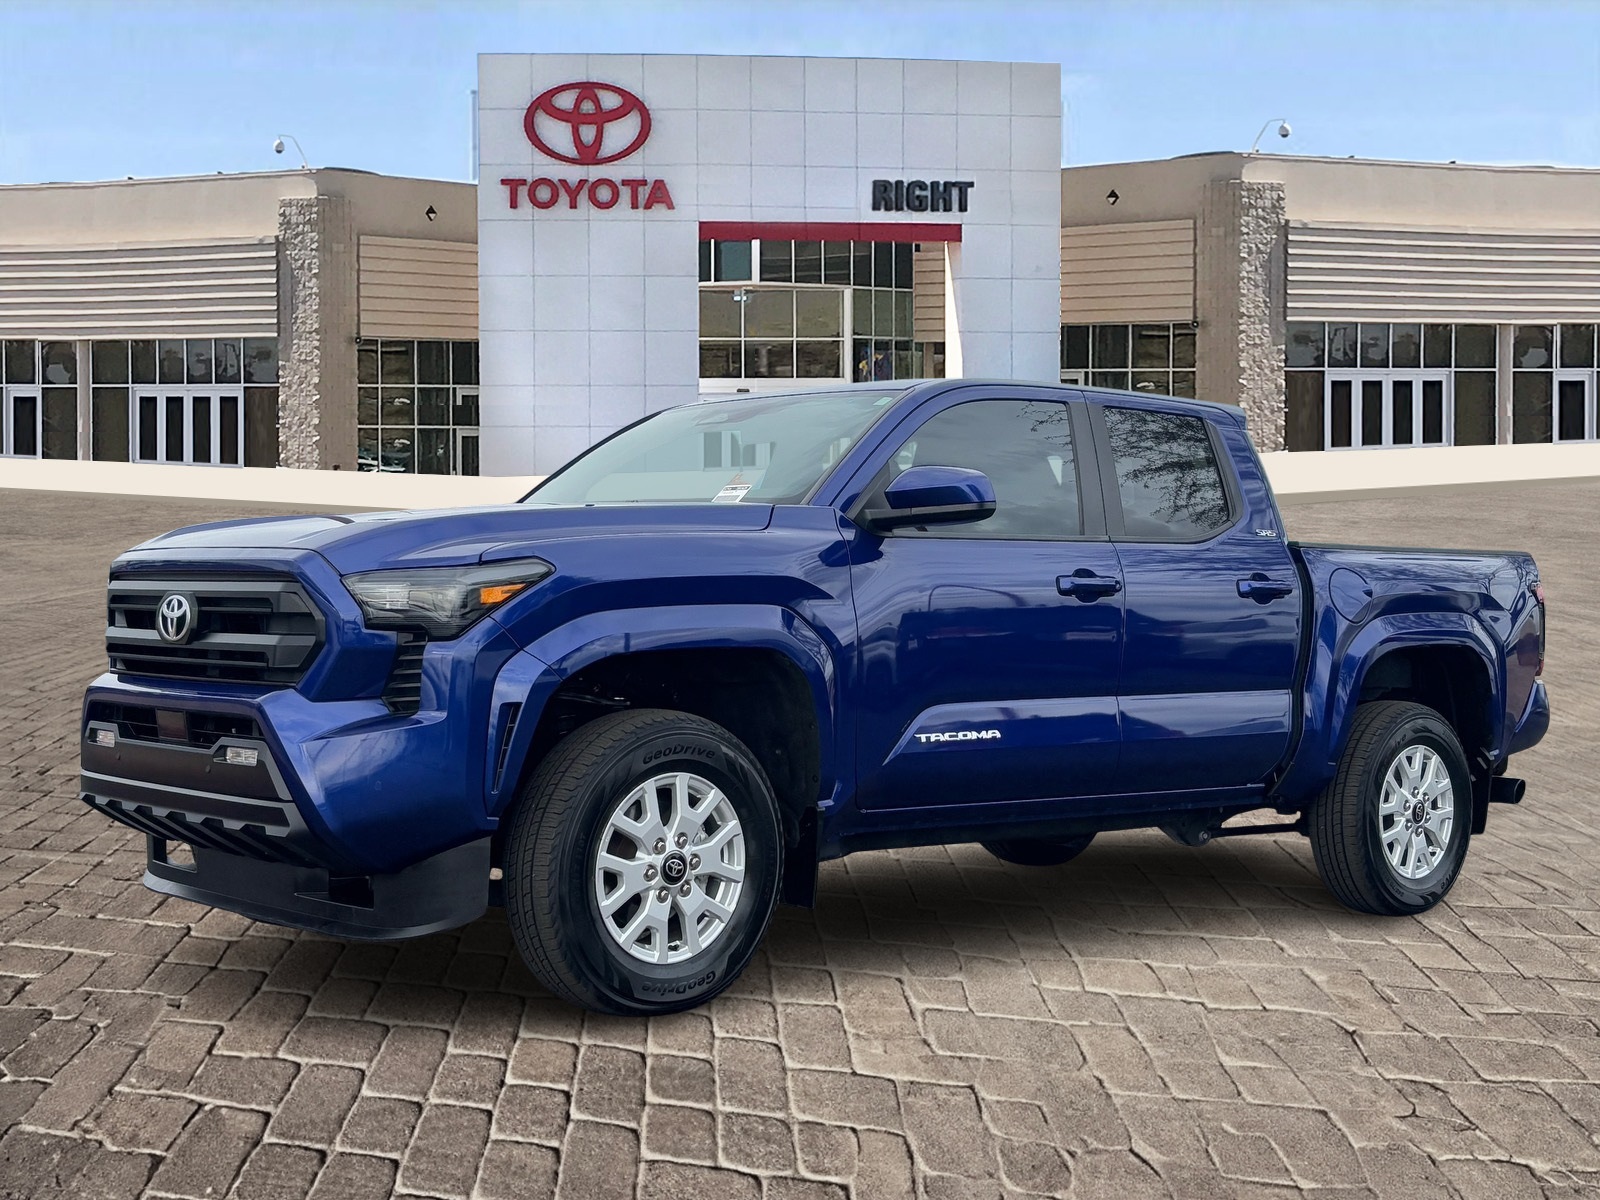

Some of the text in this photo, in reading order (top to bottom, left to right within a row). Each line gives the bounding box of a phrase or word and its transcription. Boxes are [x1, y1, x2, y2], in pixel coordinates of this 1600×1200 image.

[500, 178, 675, 210] TOYOTA
[871, 180, 974, 212] RIGHT
[914, 729, 1001, 743] TACOMA
[642, 743, 716, 765] GeoDrive
